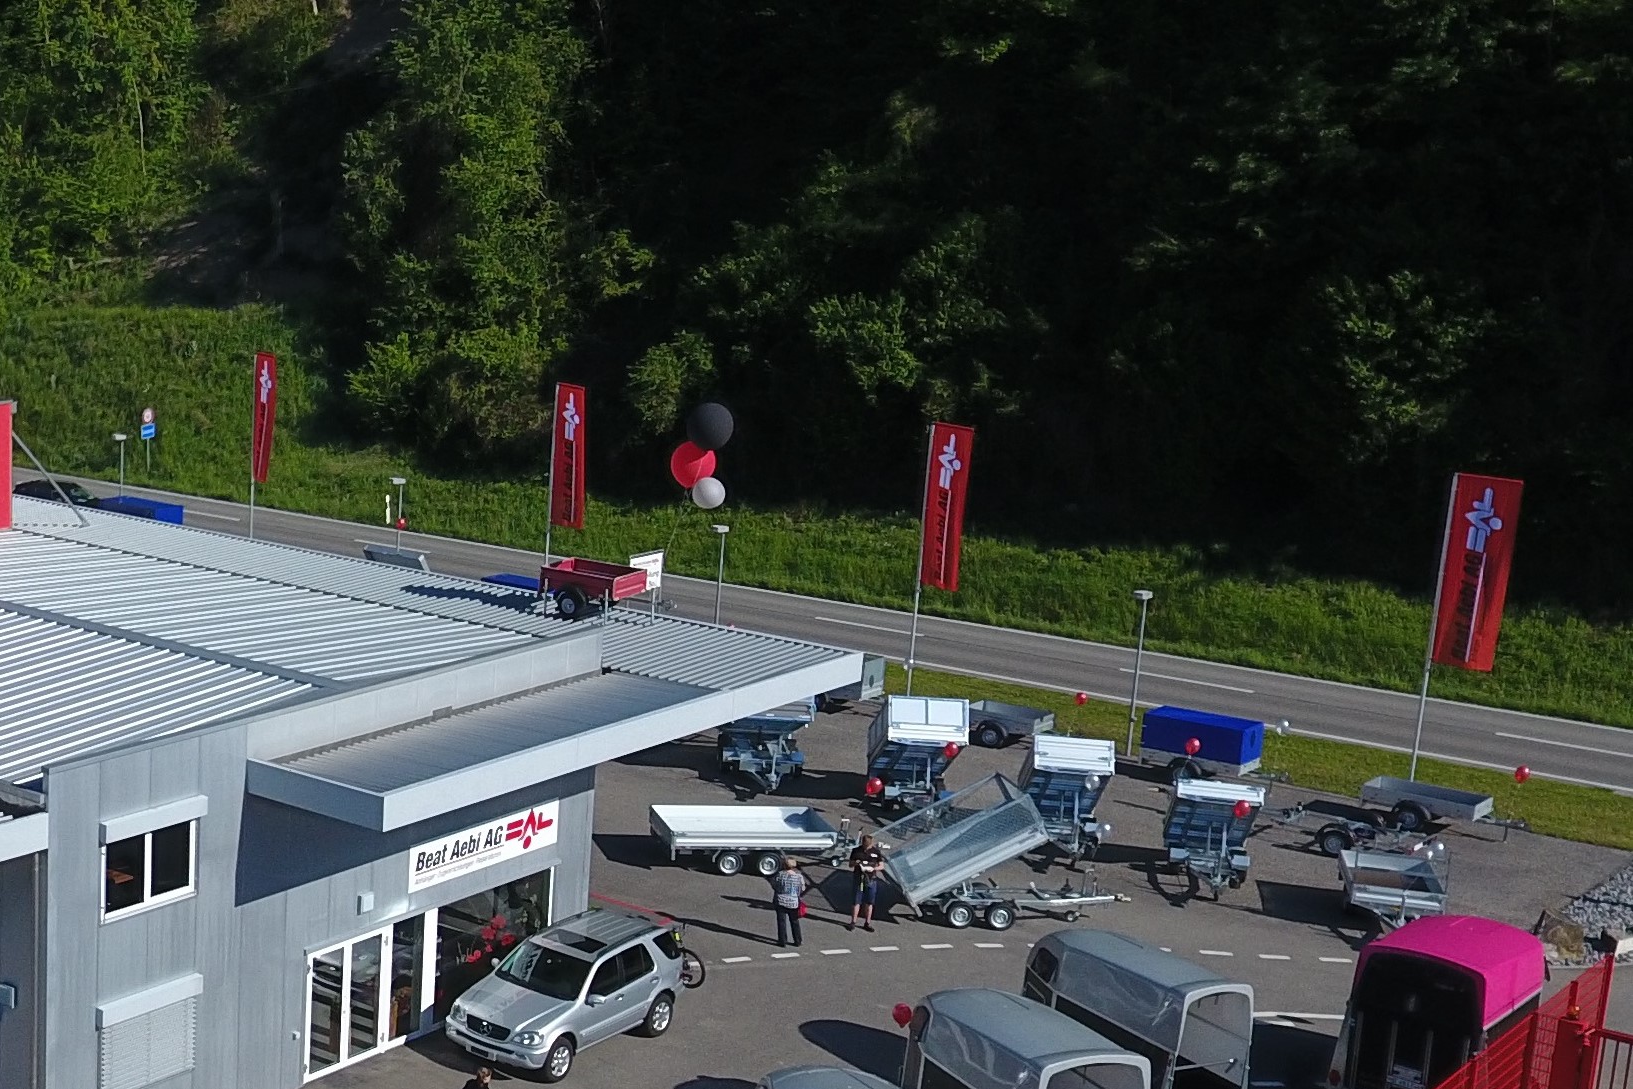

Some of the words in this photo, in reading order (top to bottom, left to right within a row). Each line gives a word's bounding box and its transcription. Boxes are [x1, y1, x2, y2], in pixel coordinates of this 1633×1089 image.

[415, 844, 448, 873] Beat
[449, 831, 482, 861] Aebi
[483, 825, 504, 849] AG
